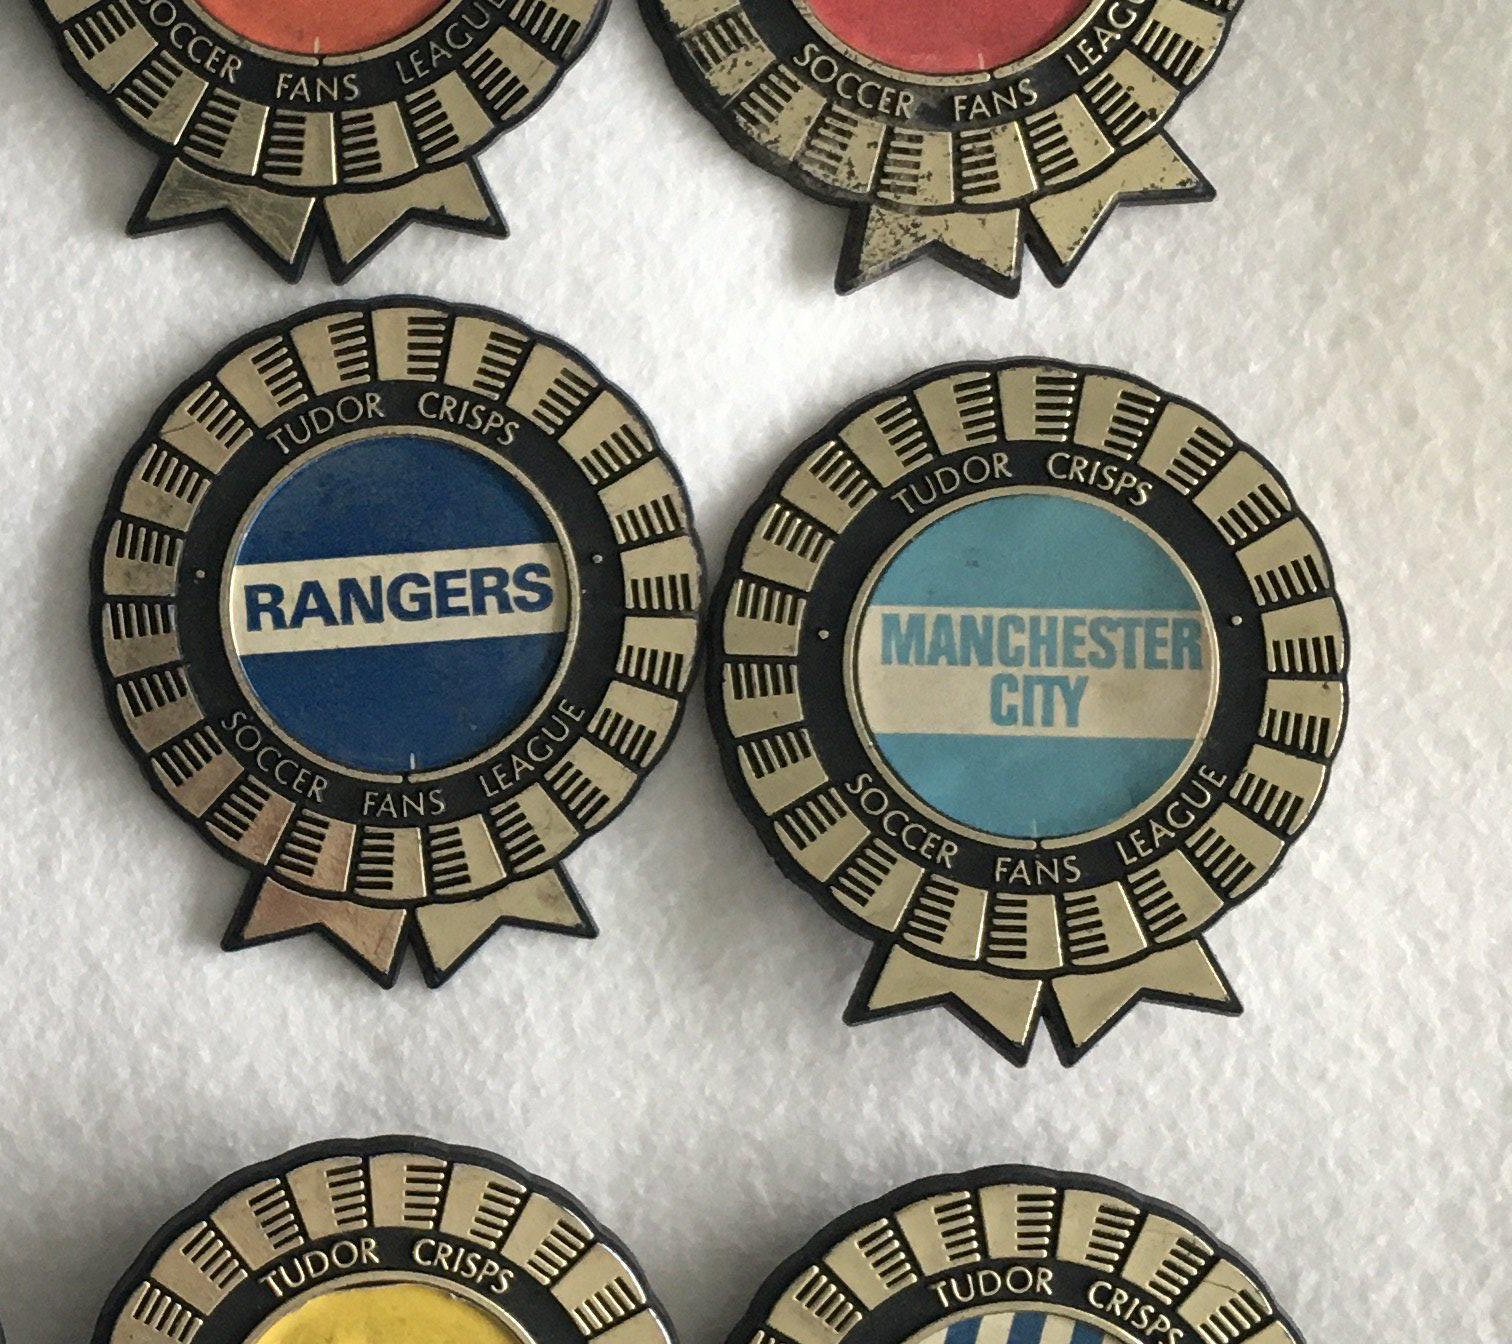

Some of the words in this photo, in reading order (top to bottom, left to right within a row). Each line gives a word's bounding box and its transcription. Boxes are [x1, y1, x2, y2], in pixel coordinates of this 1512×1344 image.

[276, 73, 361, 103] FANS
[793, 43, 915, 119] SOCCER
[953, 77, 1039, 122] FANS
[265, 391, 385, 454] TUDOR
[417, 392, 520, 446] CRISPS
[890, 452, 1013, 514] TUDOR
[1047, 453, 1153, 507] CRISPS
[243, 562, 554, 633] RANGERS
[880, 613, 1203, 671] MANCHESTER
[990, 673, 1089, 728] CITY
[221, 710, 330, 804] SOCCER
[362, 789, 447, 818] FANS
[480, 697, 587, 798] LEAGUE
[844, 773, 959, 869] SOCCER
[994, 856, 1082, 885] FANS
[1115, 763, 1228, 867] LEAGUE
[258, 1237, 381, 1299] TUDOR
[413, 1238, 516, 1295] CRISPS
[931, 1265, 1055, 1309] TUDOR
